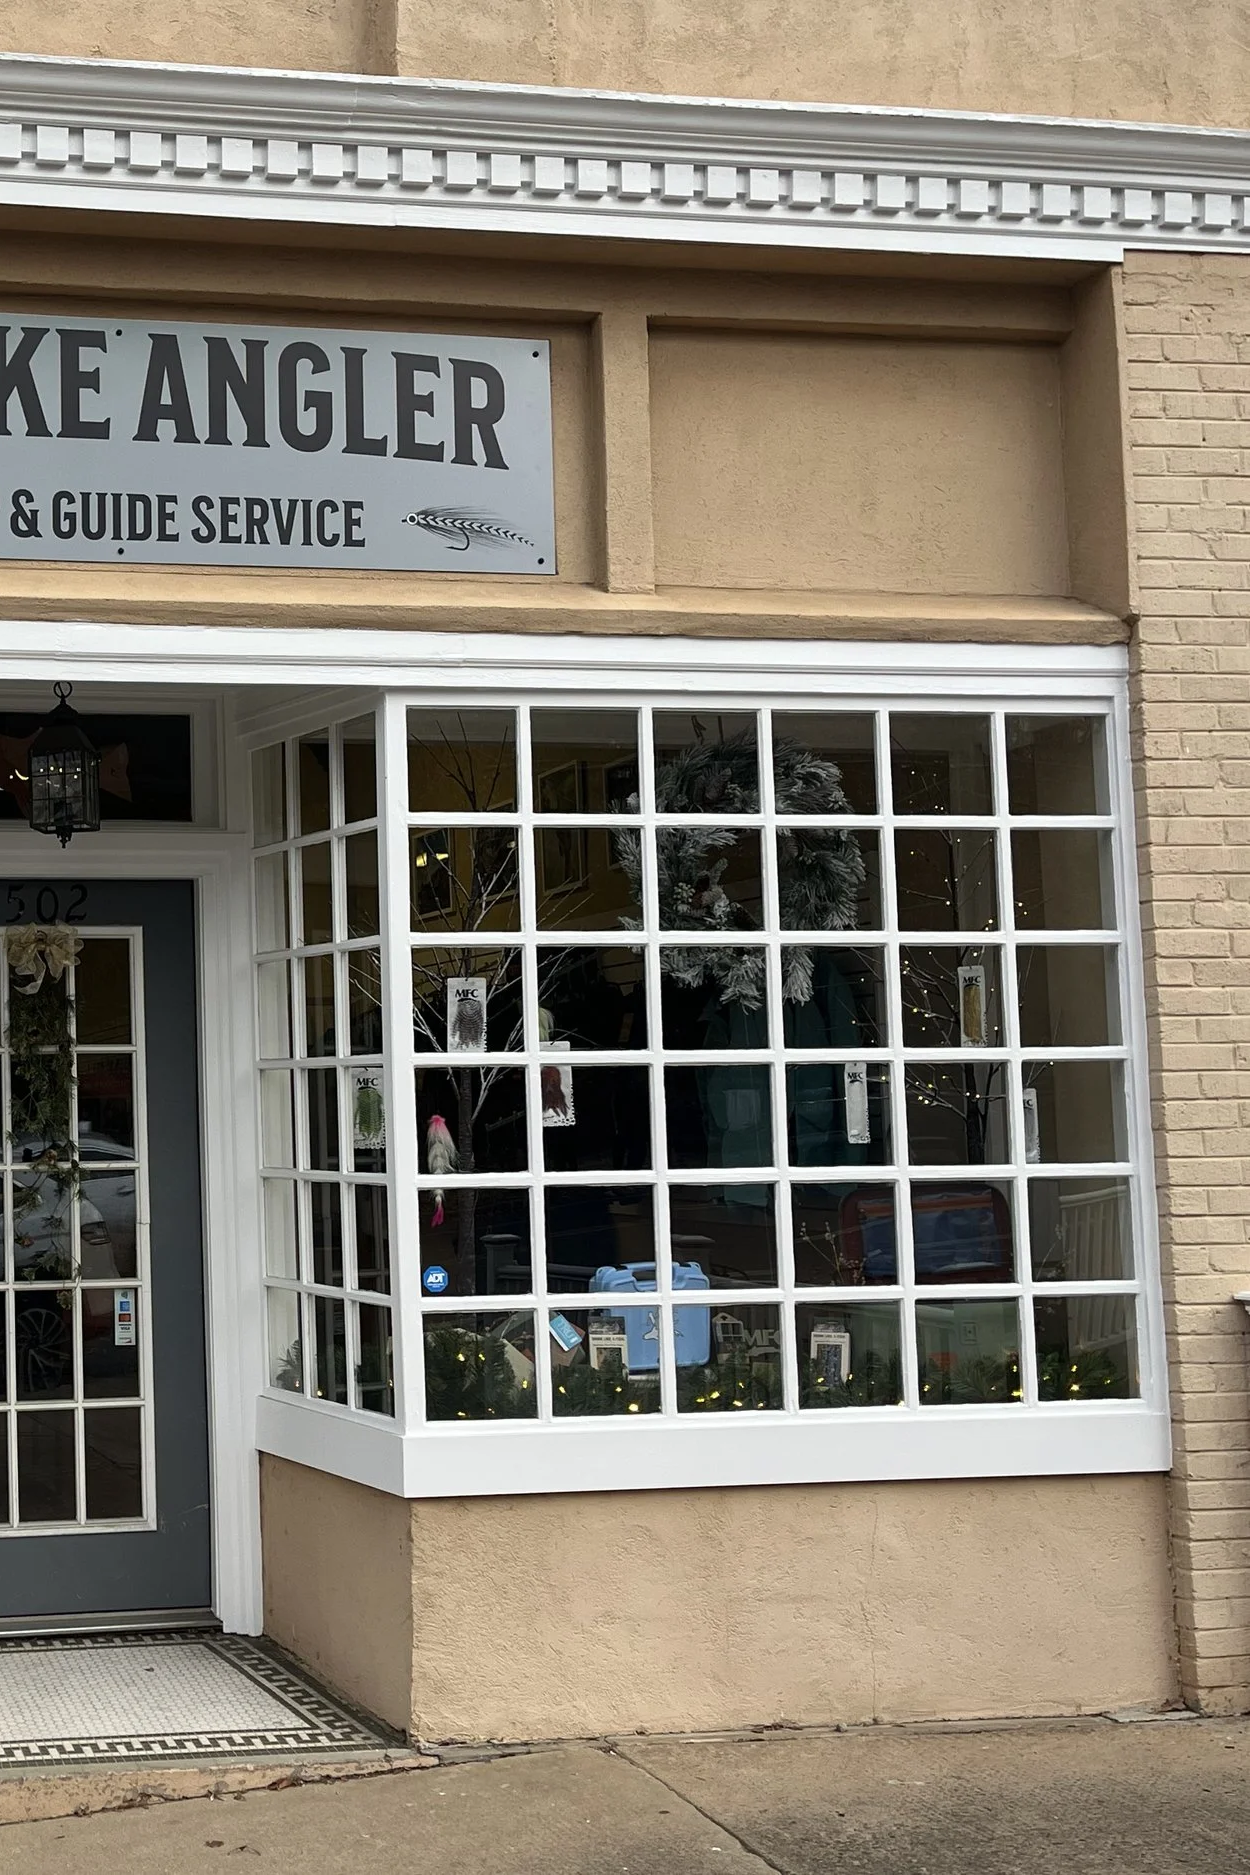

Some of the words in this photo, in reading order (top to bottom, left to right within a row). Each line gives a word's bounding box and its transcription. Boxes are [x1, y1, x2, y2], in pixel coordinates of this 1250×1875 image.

[131, 332, 510, 471] ANGLER
[9, 488, 44, 539] &
[52, 490, 180, 543] GUIDE
[190, 495, 366, 549] SERVICE
[962, 975, 981, 984] MFC
[454, 988, 479, 998] MFC
[847, 1072, 864, 1080] MFC
[356, 1077, 379, 1087] MFC
[426, 1273, 445, 1283] ADT
